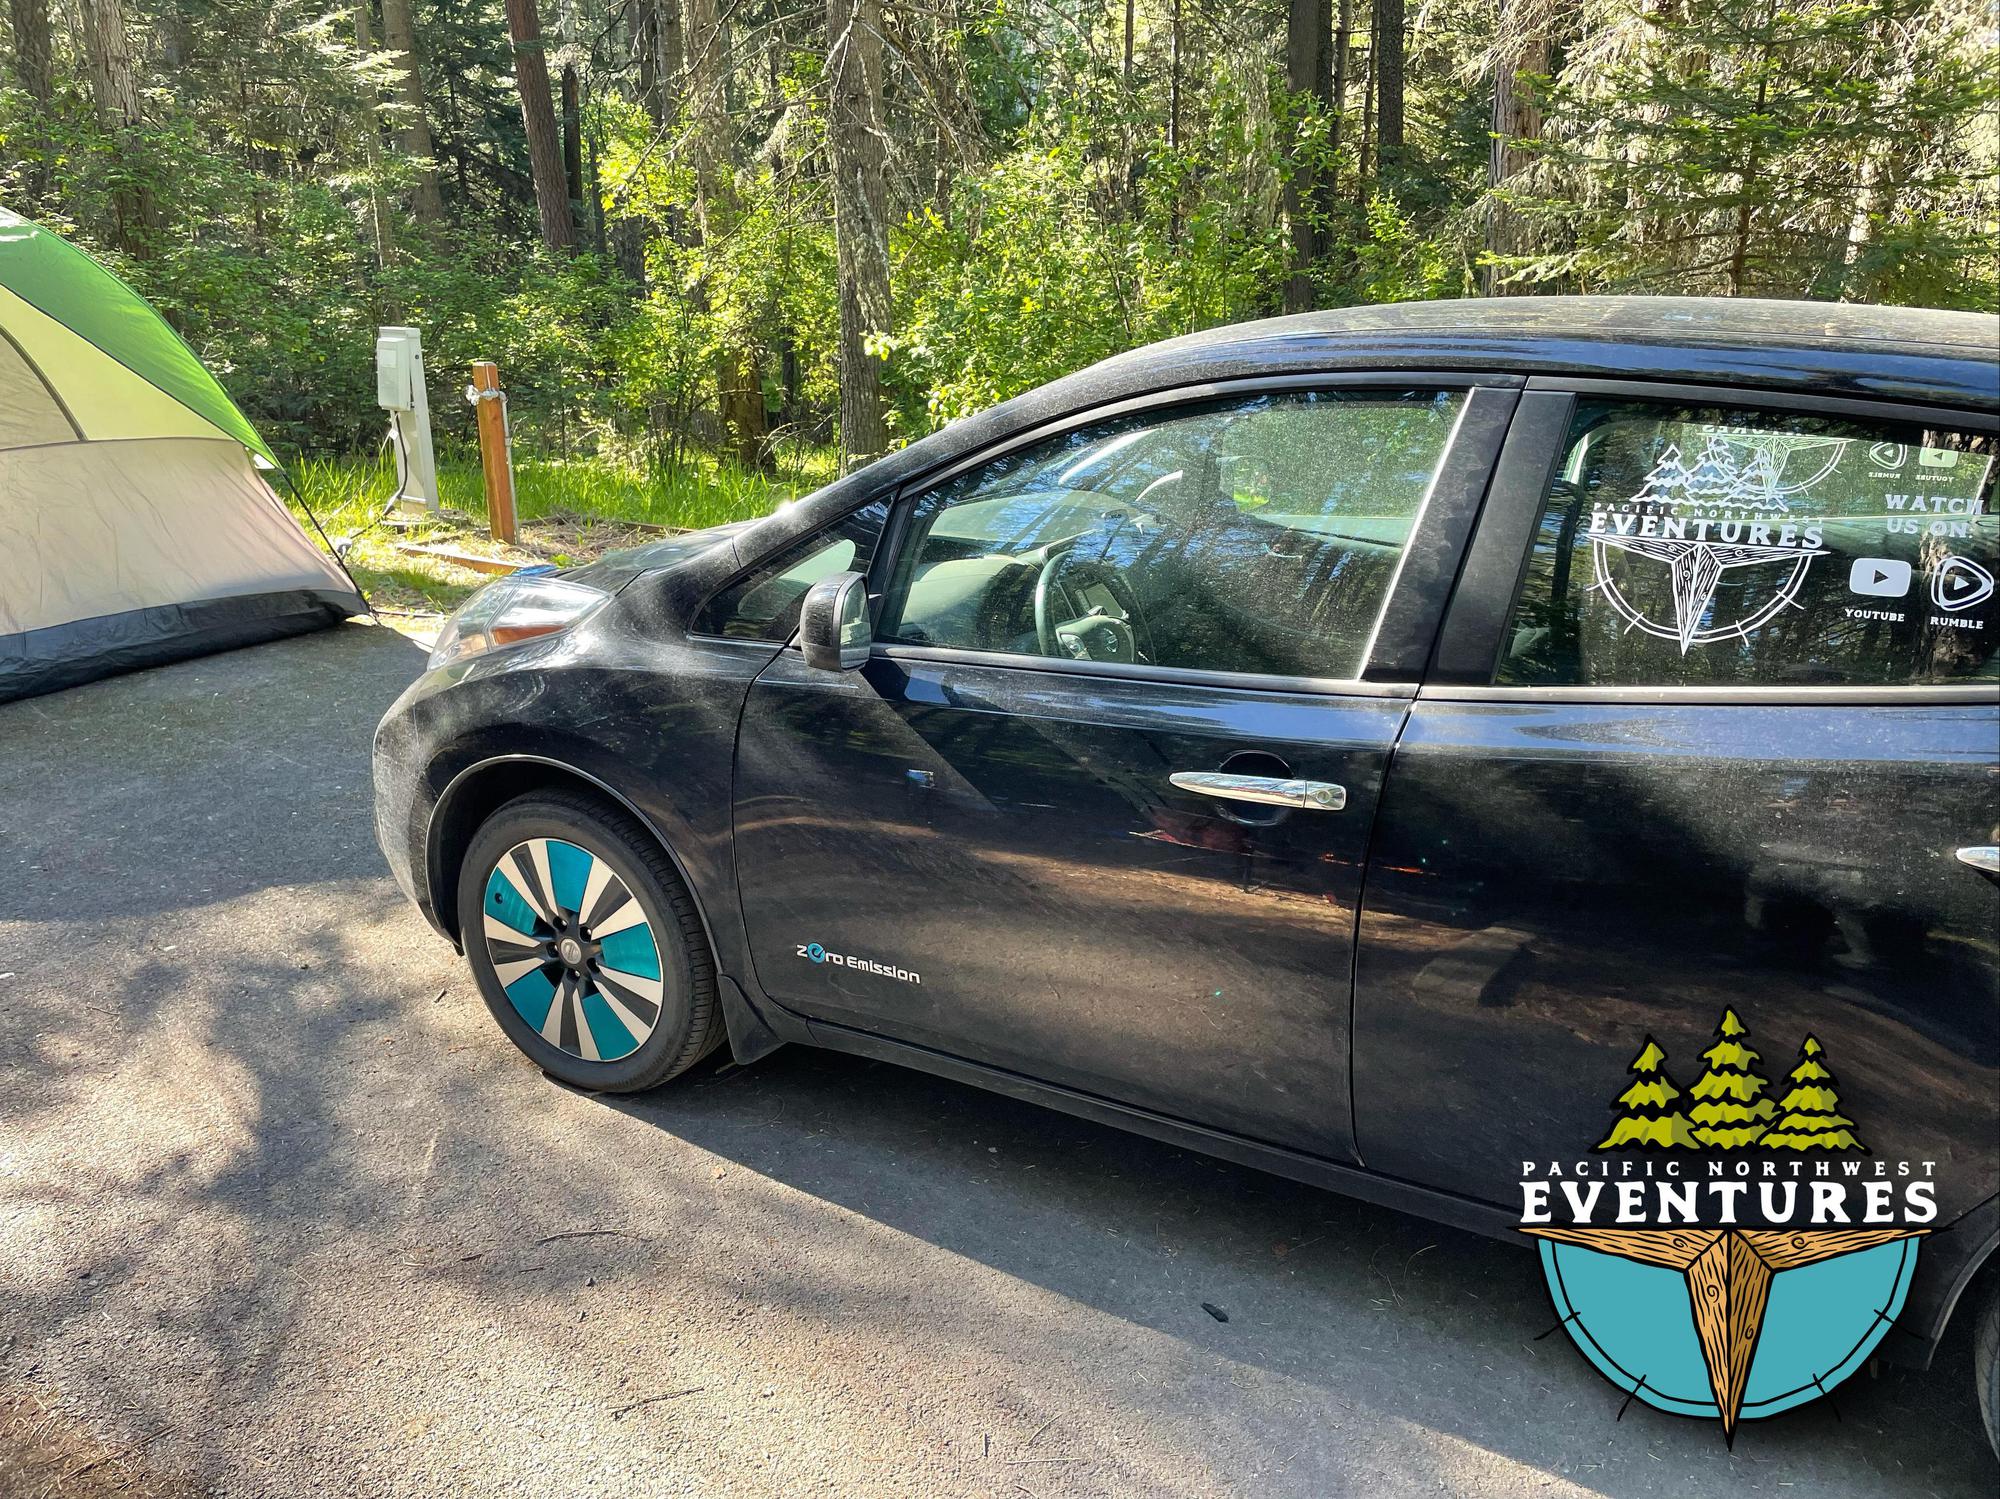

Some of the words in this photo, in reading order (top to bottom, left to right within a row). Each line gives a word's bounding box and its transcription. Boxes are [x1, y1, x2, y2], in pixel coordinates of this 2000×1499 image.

[1594, 502, 1678, 516] PACIFIC
[1885, 493, 1984, 515] WATCH
[1589, 512, 1824, 549] EVENTURES
[1887, 517, 1919, 534] US
[1844, 608, 1905, 622] YOUTUBE
[1930, 616, 1984, 630] RUMBLE
